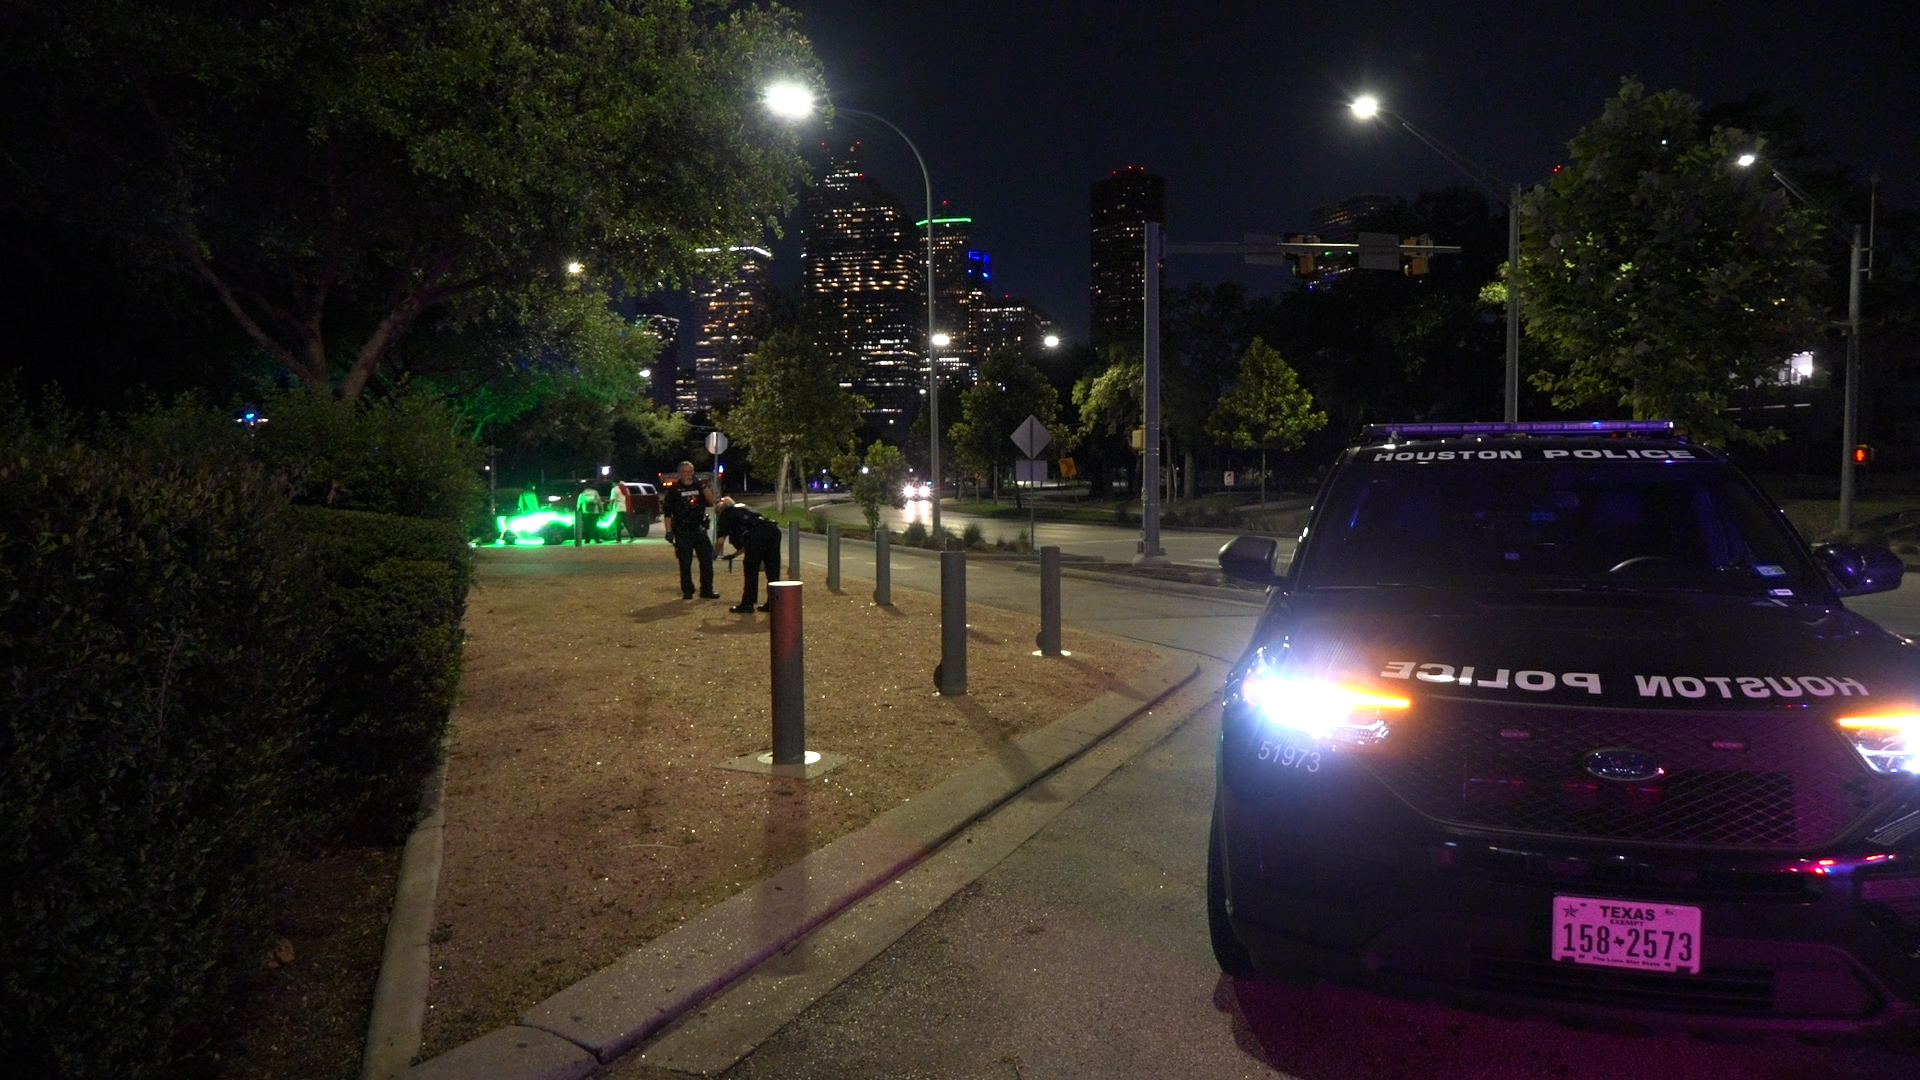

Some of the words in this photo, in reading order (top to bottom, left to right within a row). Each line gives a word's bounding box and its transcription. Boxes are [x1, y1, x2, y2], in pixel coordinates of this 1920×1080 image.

[1373, 449, 1523, 462] HOUSTON
[1542, 449, 1696, 460] POLICE
[1257, 740, 1322, 773] 51973
[1599, 904, 1656, 922] TEXAS
[1609, 918, 1644, 928] EXEMPT
